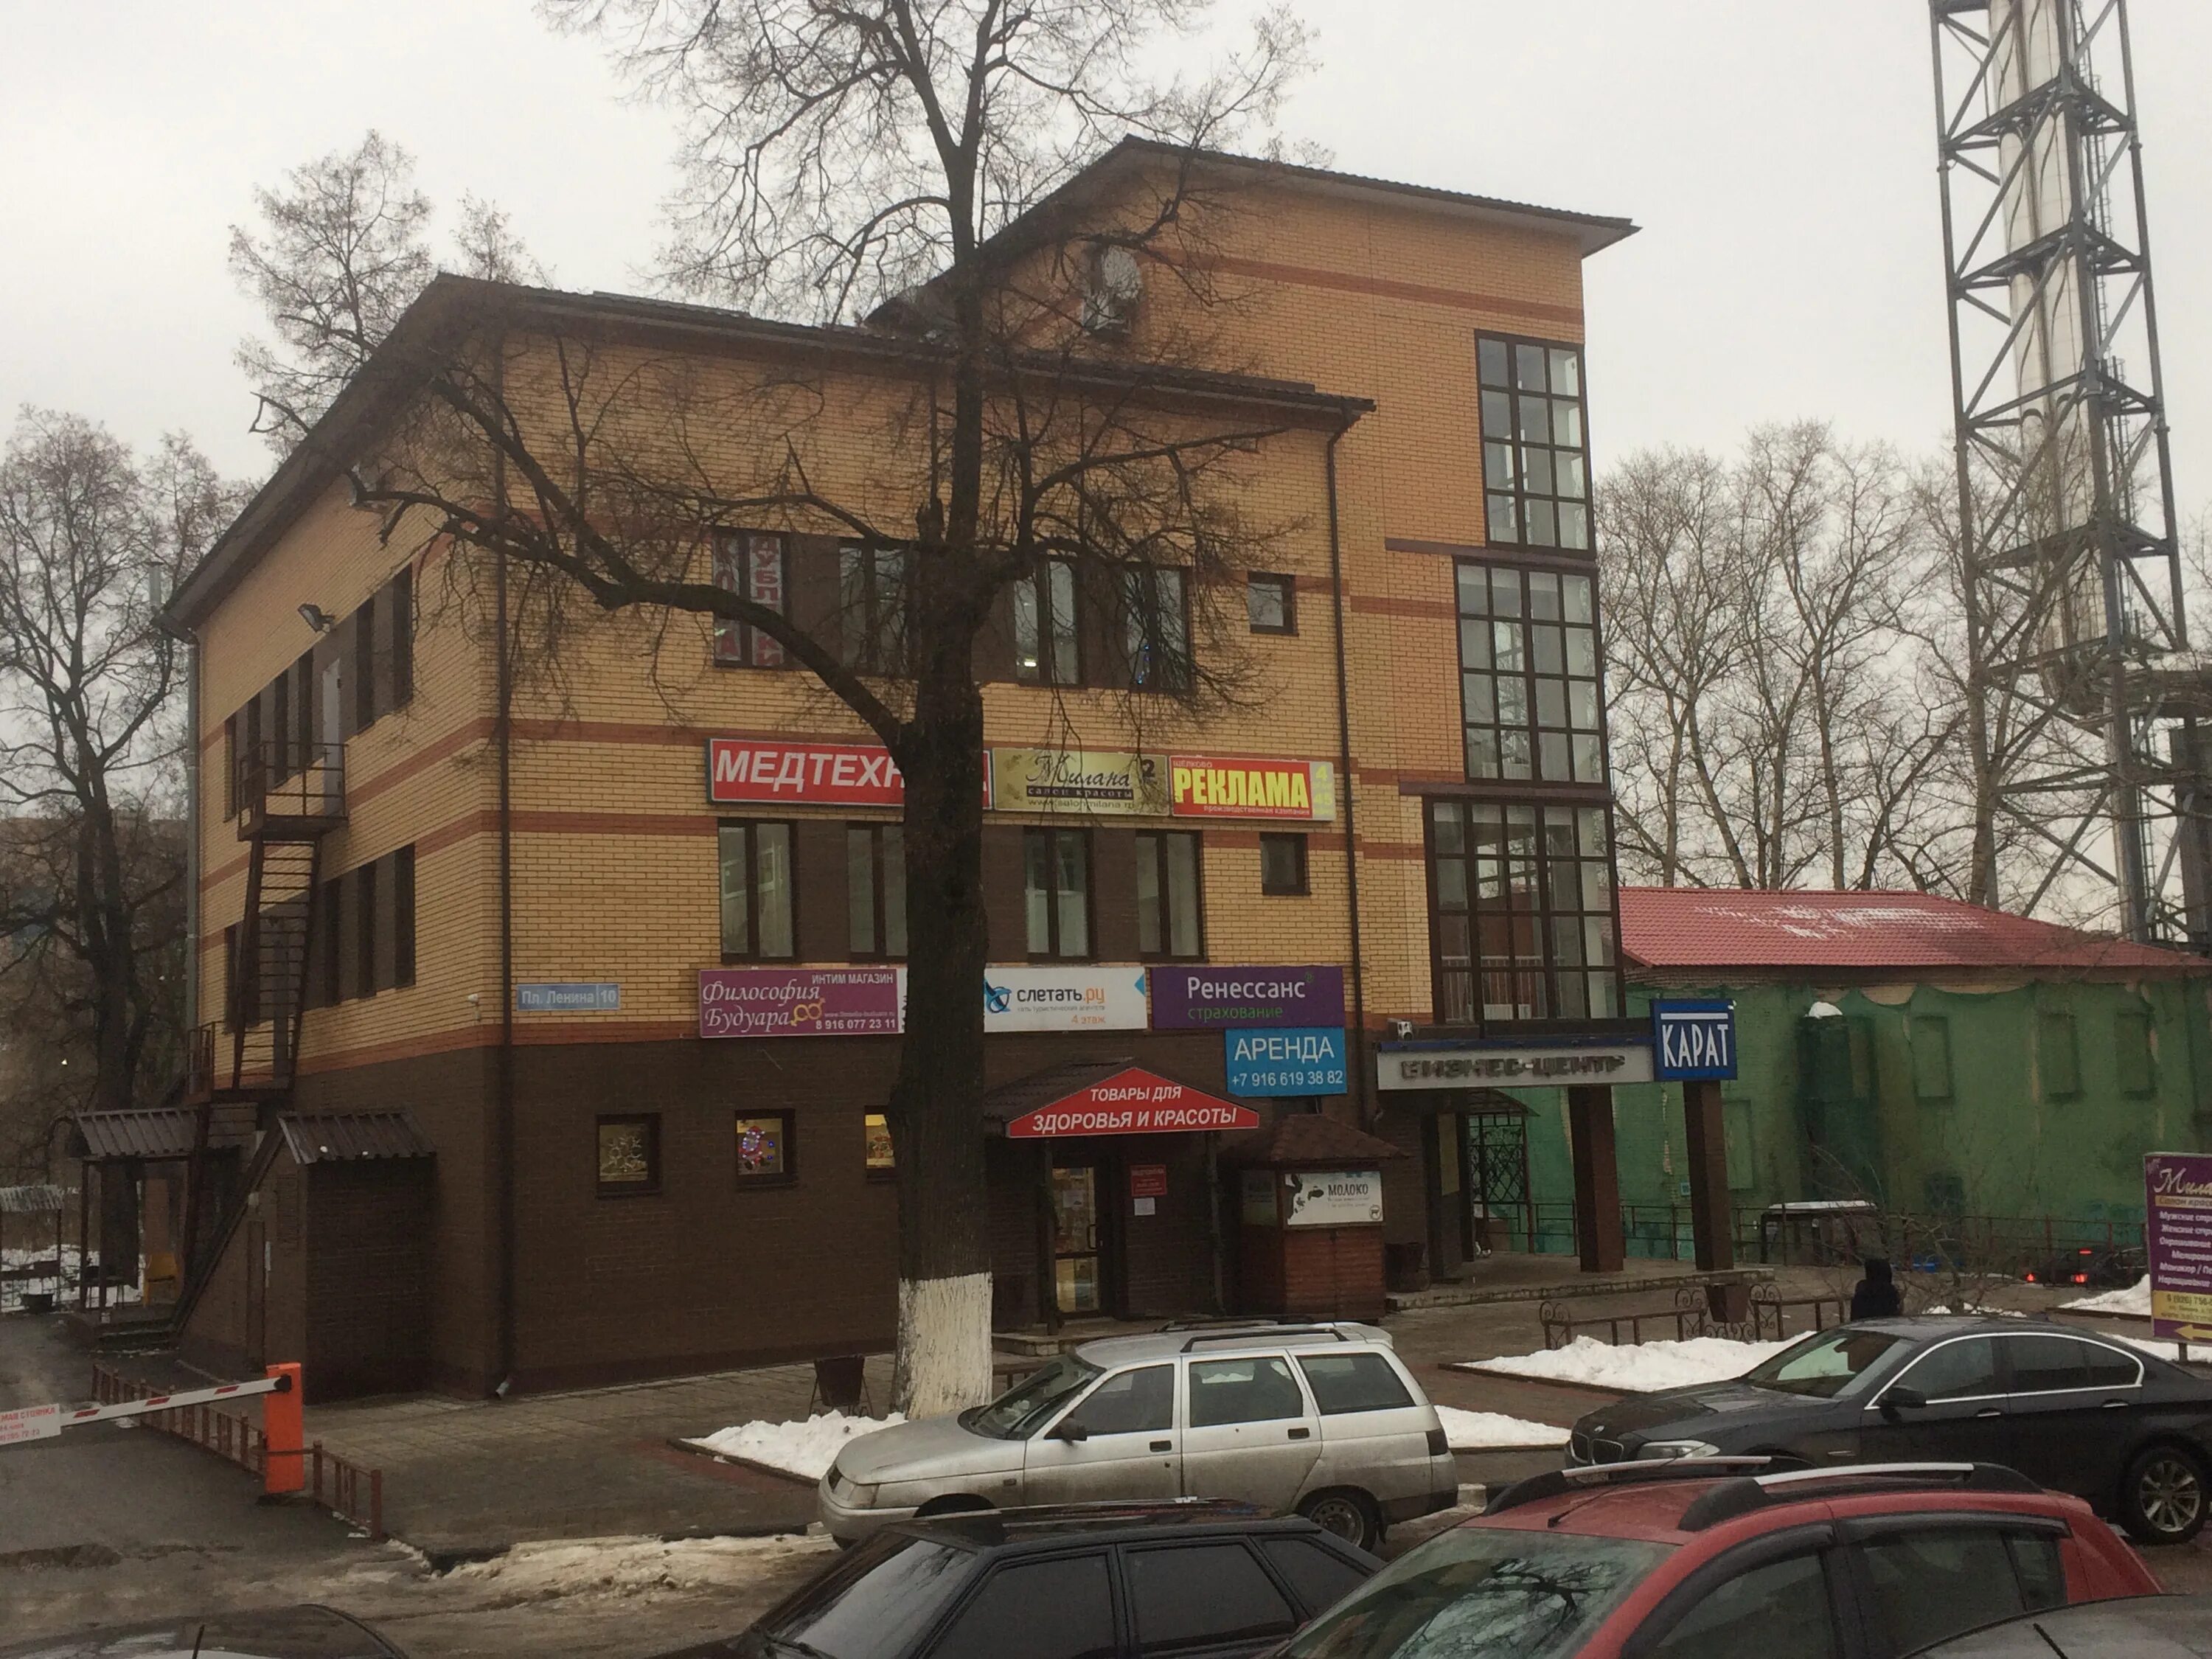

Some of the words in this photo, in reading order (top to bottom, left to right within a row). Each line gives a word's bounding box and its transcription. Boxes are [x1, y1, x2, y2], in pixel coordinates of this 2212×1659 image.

[1026, 754, 1130, 787] Милана
[1142, 759, 1155, 777] 2
[1076, 789, 1133, 799] красоты
[1173, 768, 1309, 808] РЕКЛАМА
[812, 974, 846, 984] ИНТИМ
[848, 973, 894, 984] МАГАЗИН
[702, 978, 820, 1006] Философия
[1017, 987, 1105, 1004] слетать.ру
[1187, 976, 1306, 999] Ренессанс
[522, 991, 543, 1004] Пл.
[546, 991, 594, 1004] Ленина
[600, 990, 616, 1003] 10
[705, 1005, 790, 1033] Будуара
[1071, 1015, 1079, 1024] 4
[1081, 1016, 1106, 1024] этаж
[1188, 1006, 1283, 1023] страхование
[815, 1020, 822, 1030] 8
[825, 1020, 844, 1029] 916
[847, 1020, 866, 1029] 077
[869, 1019, 882, 1029] 23
[884, 1019, 896, 1028] 11
[1234, 1036, 1335, 1065] АРЕНДА
[1662, 1024, 1729, 1068] КАРАТ
[1232, 1073, 1248, 1087] +7
[1252, 1072, 1276, 1087] 916
[1280, 1071, 1304, 1086] 619
[1307, 1070, 1324, 1085] 38
[1327, 1070, 1343, 1085] 82
[1091, 1087, 1150, 1102] ТОВАРЫ
[1152, 1086, 1182, 1102] ДЛЯ
[1032, 1112, 1133, 1134] ЗДОРОВЬЯ
[1136, 1110, 1150, 1127] И
[1153, 1107, 1238, 1127] КРАСОТЫ
[1328, 1183, 1368, 1196] МОЛОКО
